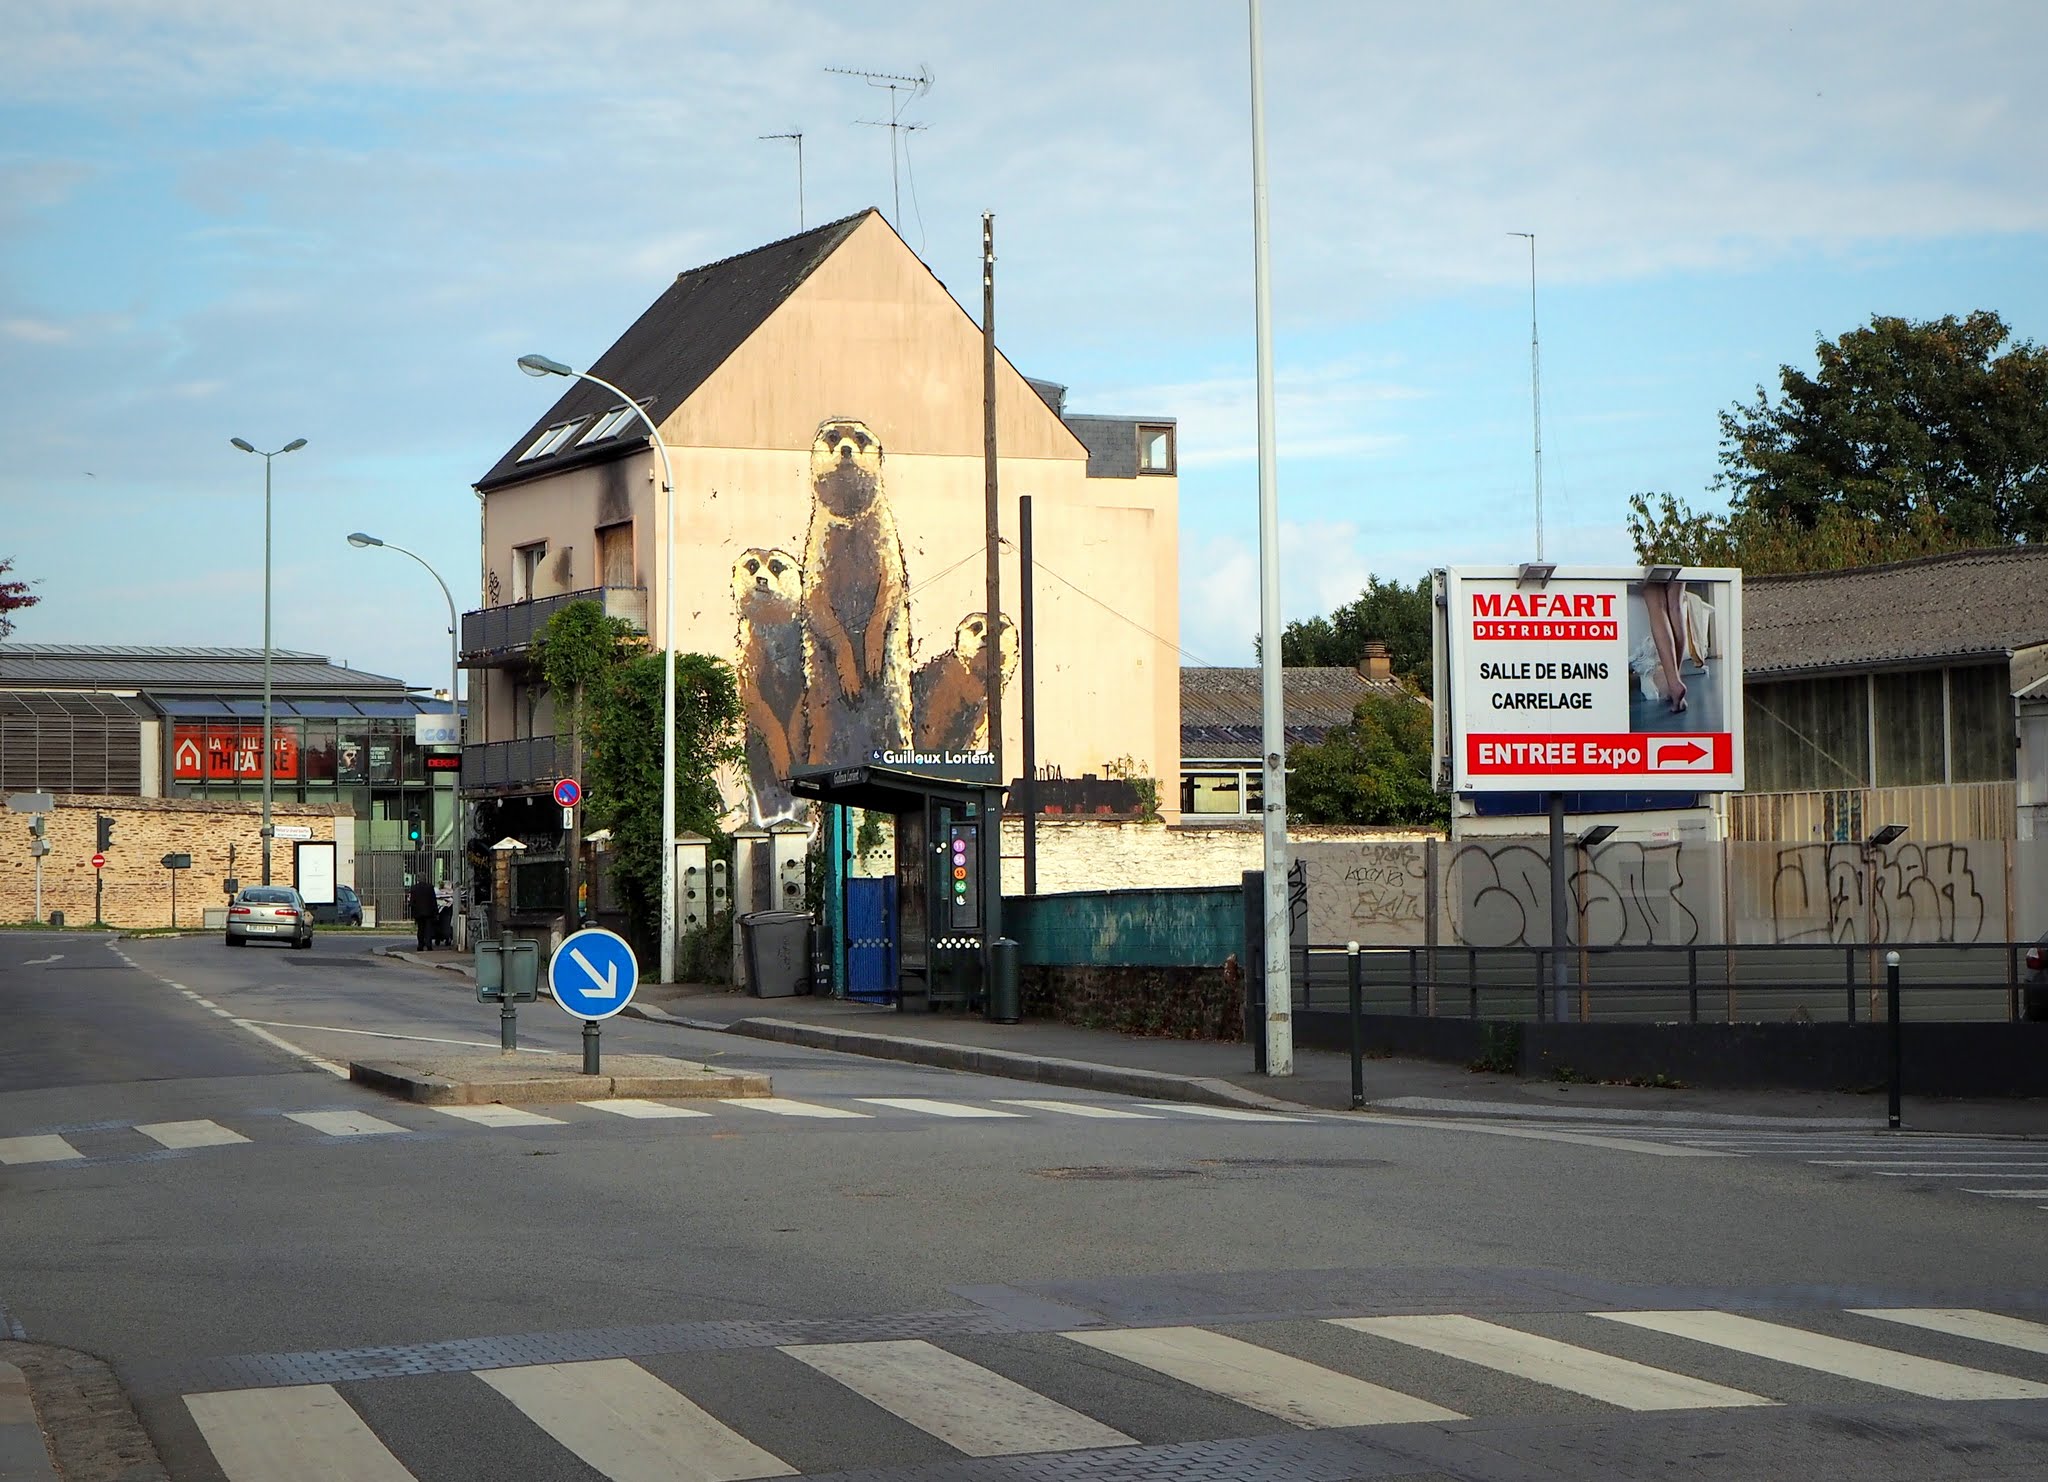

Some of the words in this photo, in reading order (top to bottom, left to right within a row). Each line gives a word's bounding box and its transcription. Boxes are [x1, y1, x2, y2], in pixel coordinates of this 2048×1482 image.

[1472, 594, 1617, 617] MAFART
[1476, 624, 1615, 637] DISTRIBUTION
[1480, 663, 1531, 679] SALLE
[1536, 663, 1557, 679] DE
[1561, 663, 1609, 679] BAINS
[1491, 693, 1593, 709] CARRELAGE
[209, 737, 221, 750] LA
[225, 737, 287, 750] PAILLETE
[883, 751, 941, 765] Guilloux
[945, 751, 995, 765] Lorient
[1478, 743, 1577, 764] ENTREE
[1582, 743, 1641, 769] Expo
